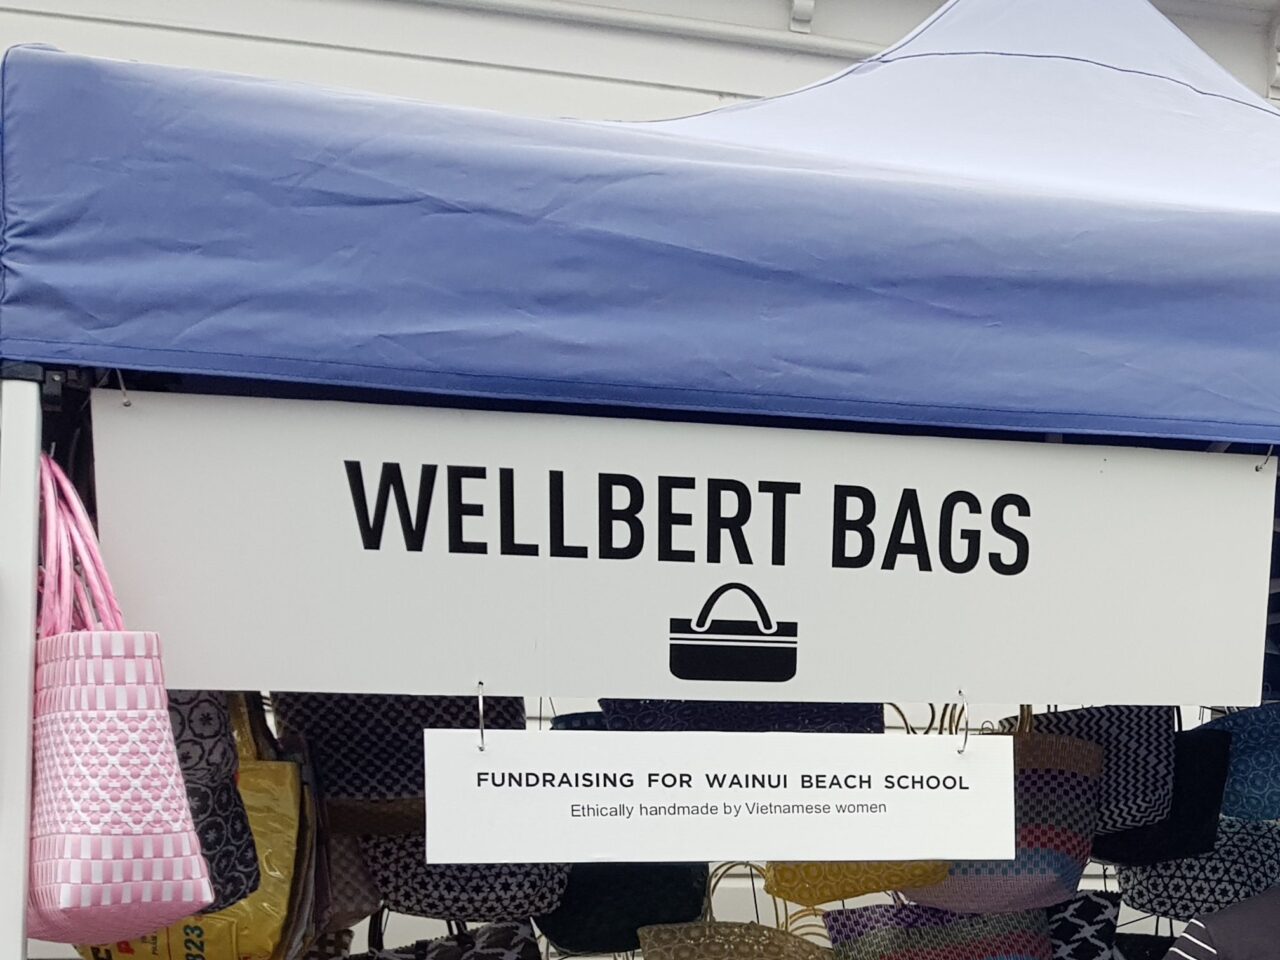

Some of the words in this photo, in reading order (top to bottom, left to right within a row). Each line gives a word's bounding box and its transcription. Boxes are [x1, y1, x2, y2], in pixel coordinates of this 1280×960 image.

[343, 460, 801, 567] WELLBERT
[831, 484, 1031, 576] BAGS
[476, 772, 634, 788] FUNDRAISING
[647, 772, 693, 789] FOR
[705, 773, 788, 789] WAINUI
[800, 774, 872, 790] BEACH
[884, 774, 970, 790] SCHOOL
[570, 803, 635, 819] Ethically
[639, 802, 719, 816] handmade
[723, 802, 742, 818] by
[744, 802, 831, 815] Vietnamese
[835, 803, 887, 814] women
